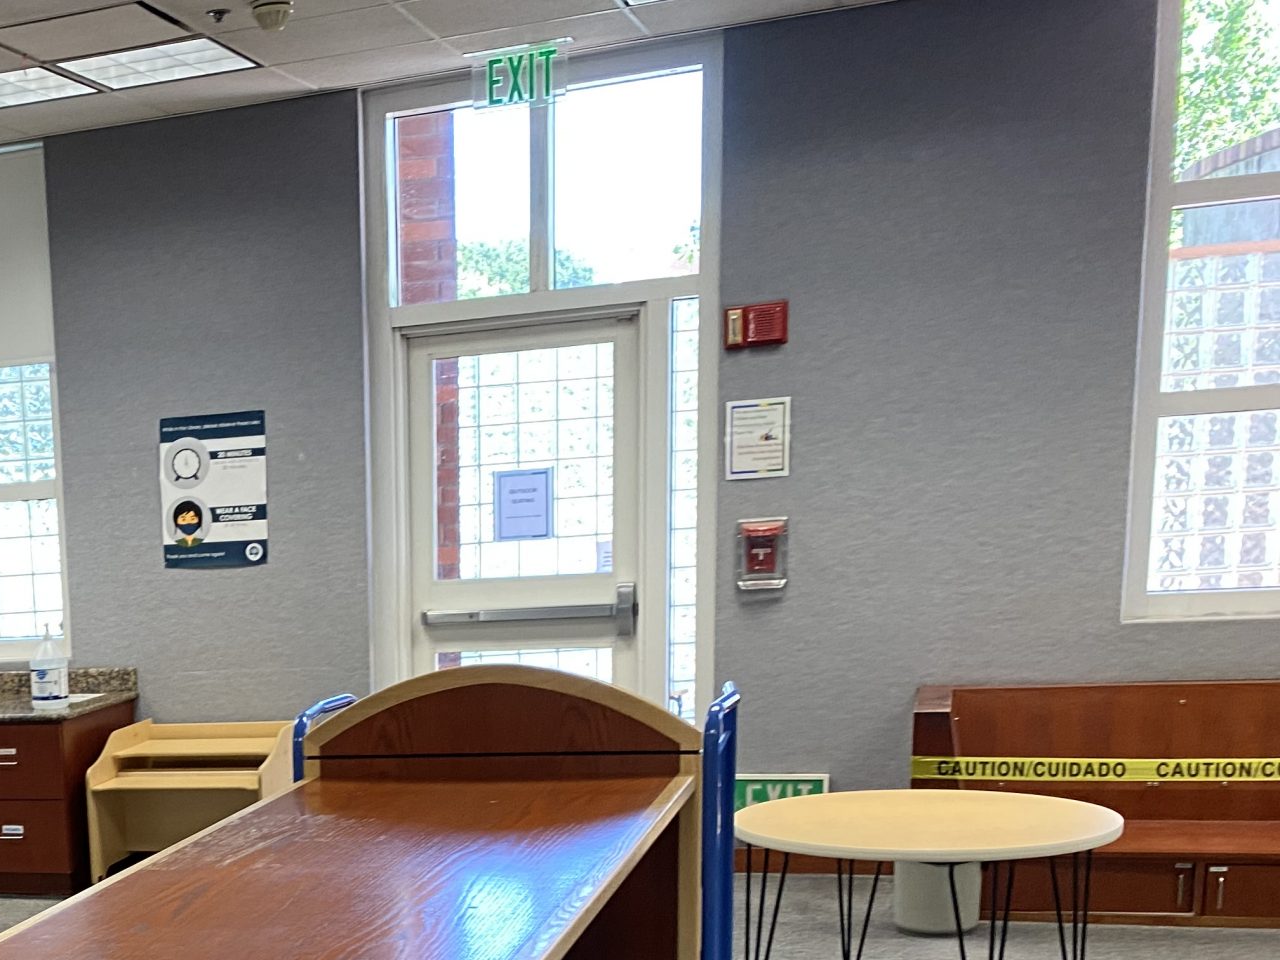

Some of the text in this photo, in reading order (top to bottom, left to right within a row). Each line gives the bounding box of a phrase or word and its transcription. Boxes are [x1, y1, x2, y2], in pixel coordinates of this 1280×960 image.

[487, 48, 558, 106] EXIT
[215, 506, 233, 514] WEAR
[240, 505, 257, 513] FACE
[937, 760, 1280, 778] CAUTION/CUIDADO CAUTION/C
